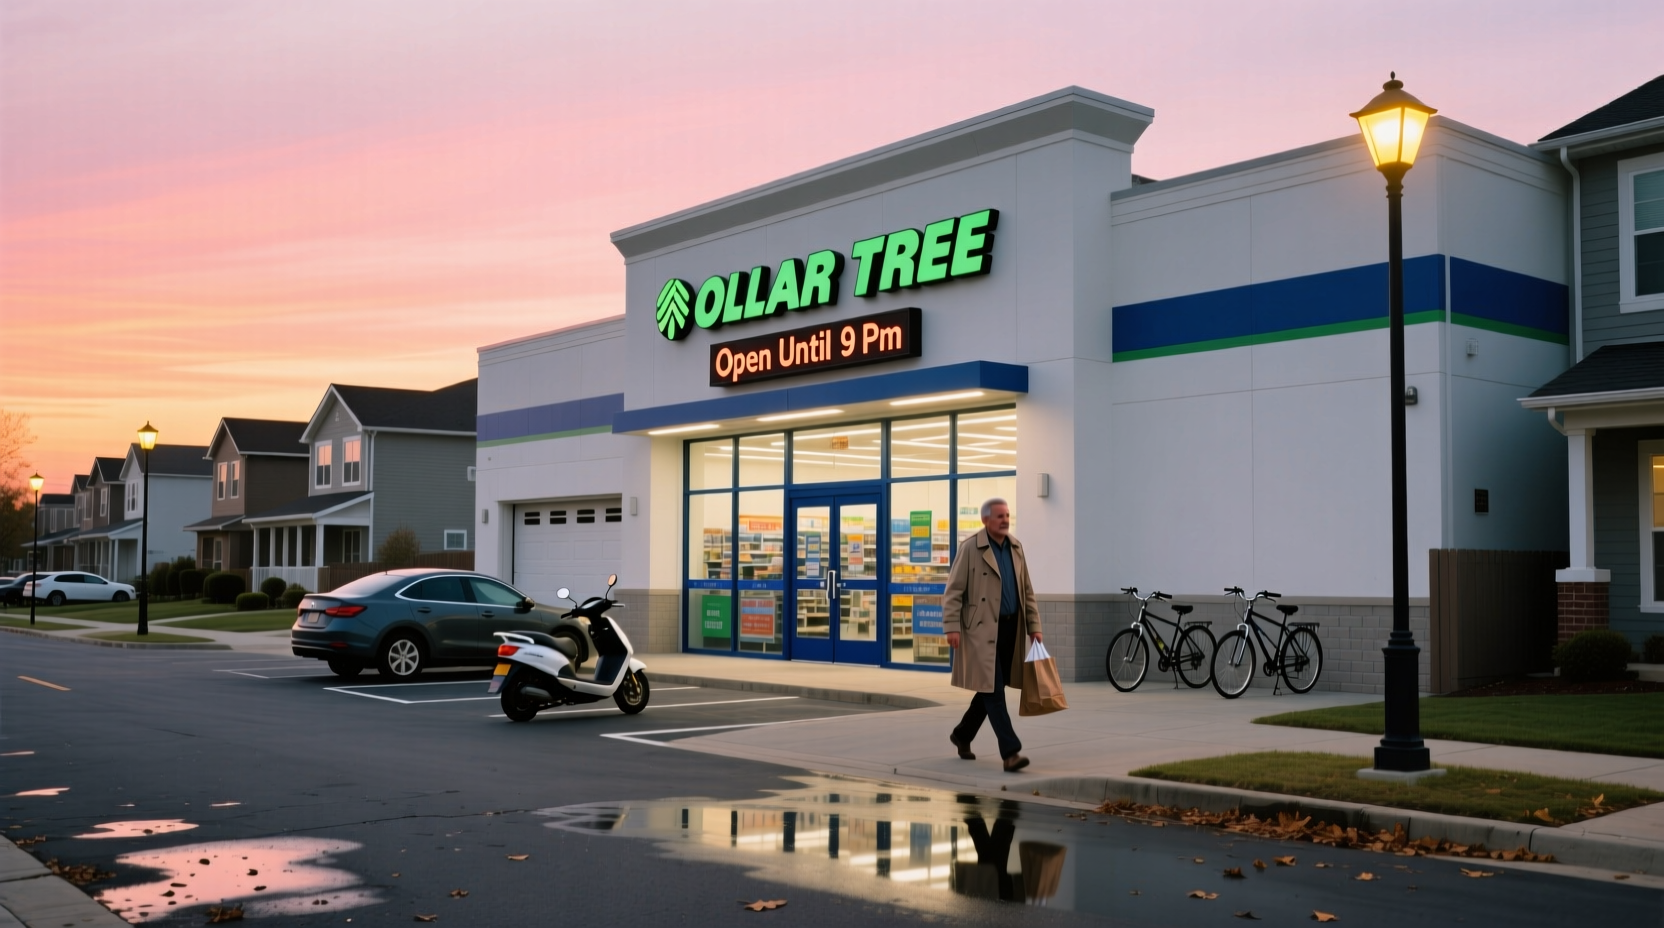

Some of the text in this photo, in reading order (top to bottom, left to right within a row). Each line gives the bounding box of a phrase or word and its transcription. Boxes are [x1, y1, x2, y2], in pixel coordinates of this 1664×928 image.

[852, 209, 992, 297] TREE
[715, 322, 902, 383] Open Until 9 Pm
